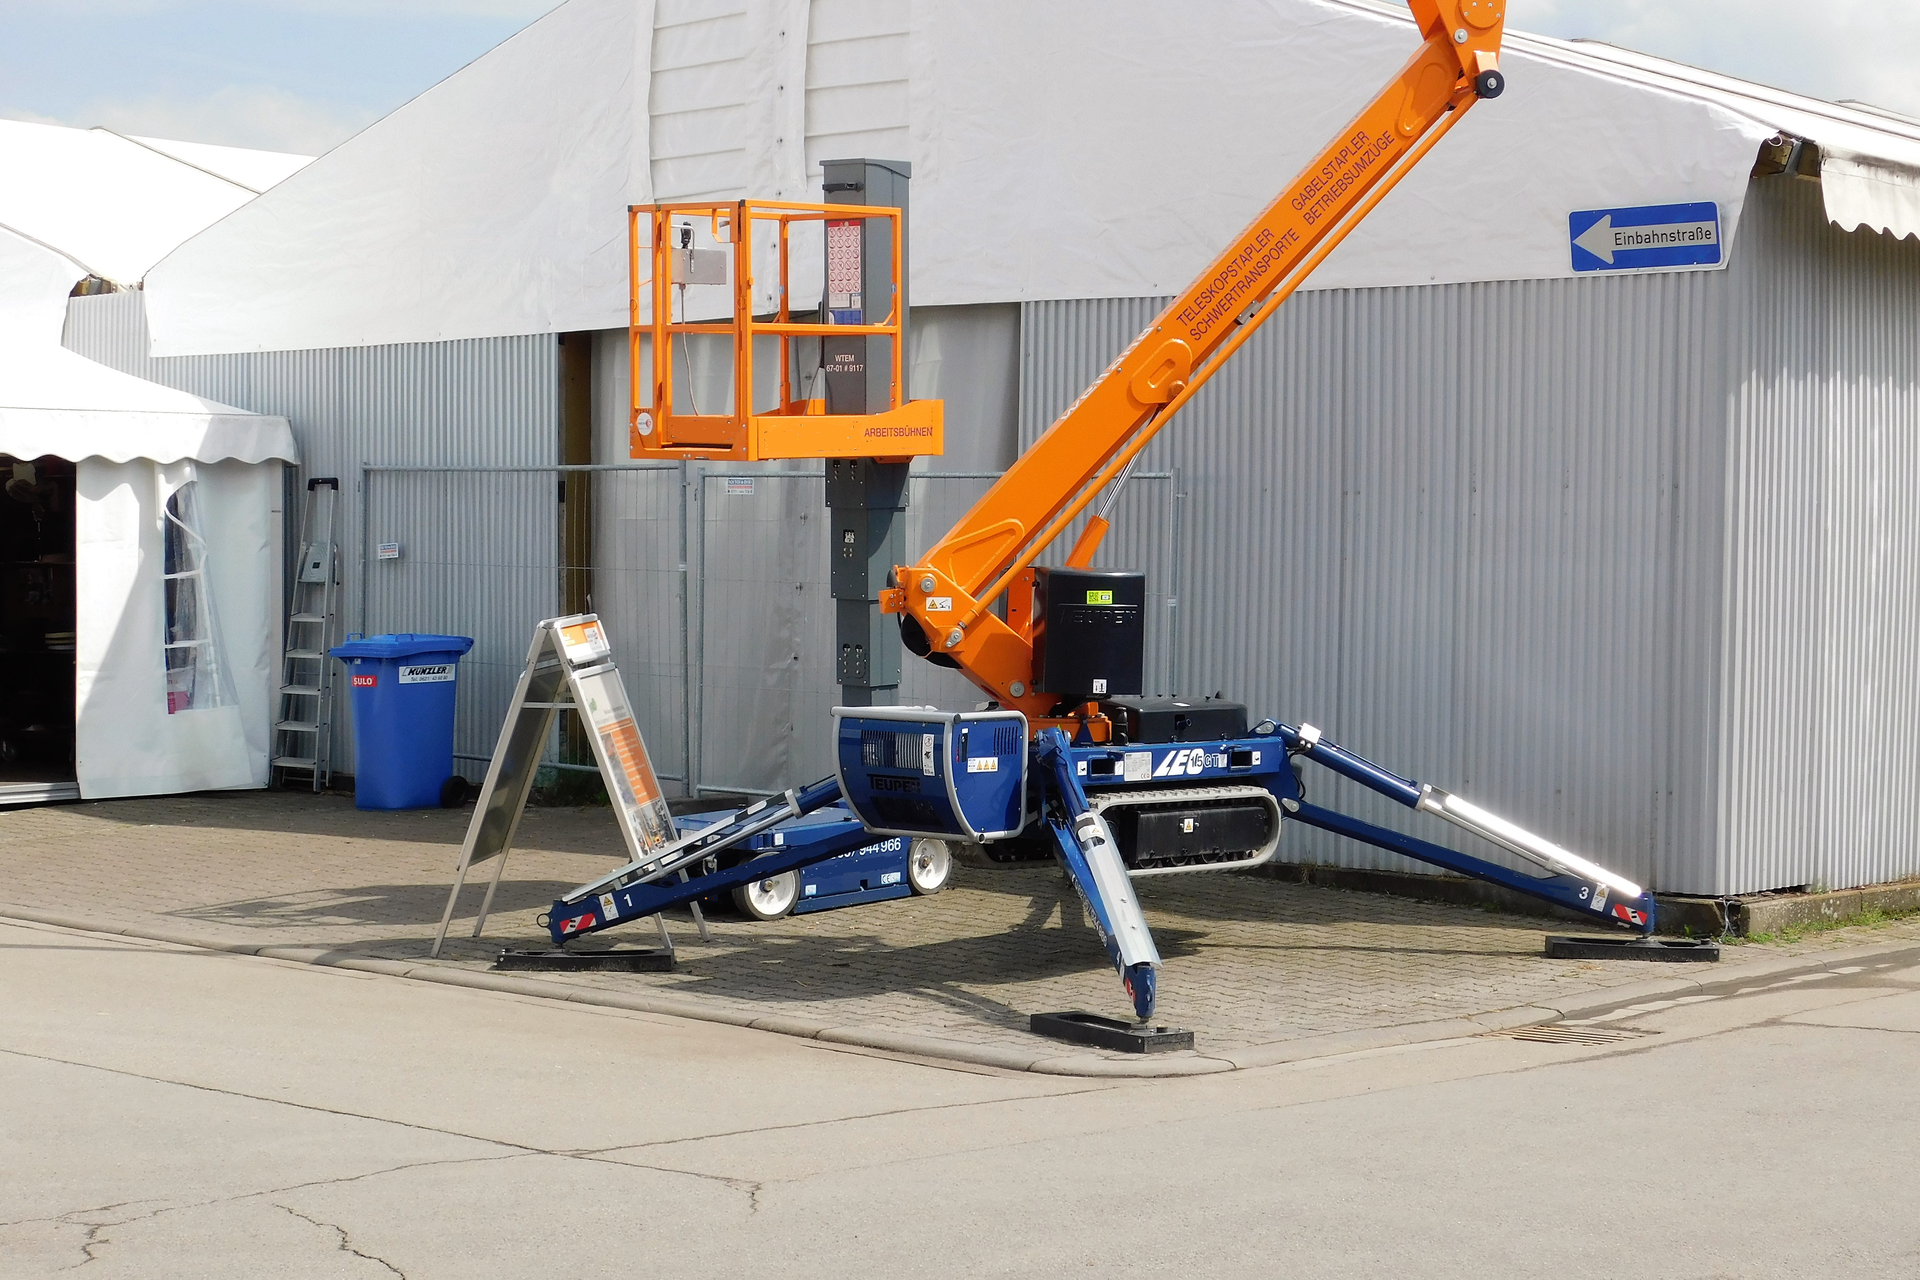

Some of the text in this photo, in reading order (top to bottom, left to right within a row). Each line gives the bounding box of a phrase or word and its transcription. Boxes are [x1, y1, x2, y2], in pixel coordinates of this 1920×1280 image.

[1176, 130, 1370, 327] TELESKOPSTAPLER GABELSTAPLER
[1189, 130, 1395, 341] SCHWERTRANSPORTE BETRIEBSUMZÜGE
[1614, 226, 1712, 246] Einbahnstraße
[835, 354, 855, 362] WTEM
[826, 364, 843, 372] 67-01
[849, 364, 864, 372] 9117
[864, 425, 933, 437] ARBEITSBÜHNEN
[353, 677, 373, 686] SULO
[1152, 748, 1205, 777] LEO
[866, 774, 921, 794] TEUPEN
[881, 838, 901, 852] 966
[623, 893, 633, 907] 1
[1579, 886, 1590, 900] 3
